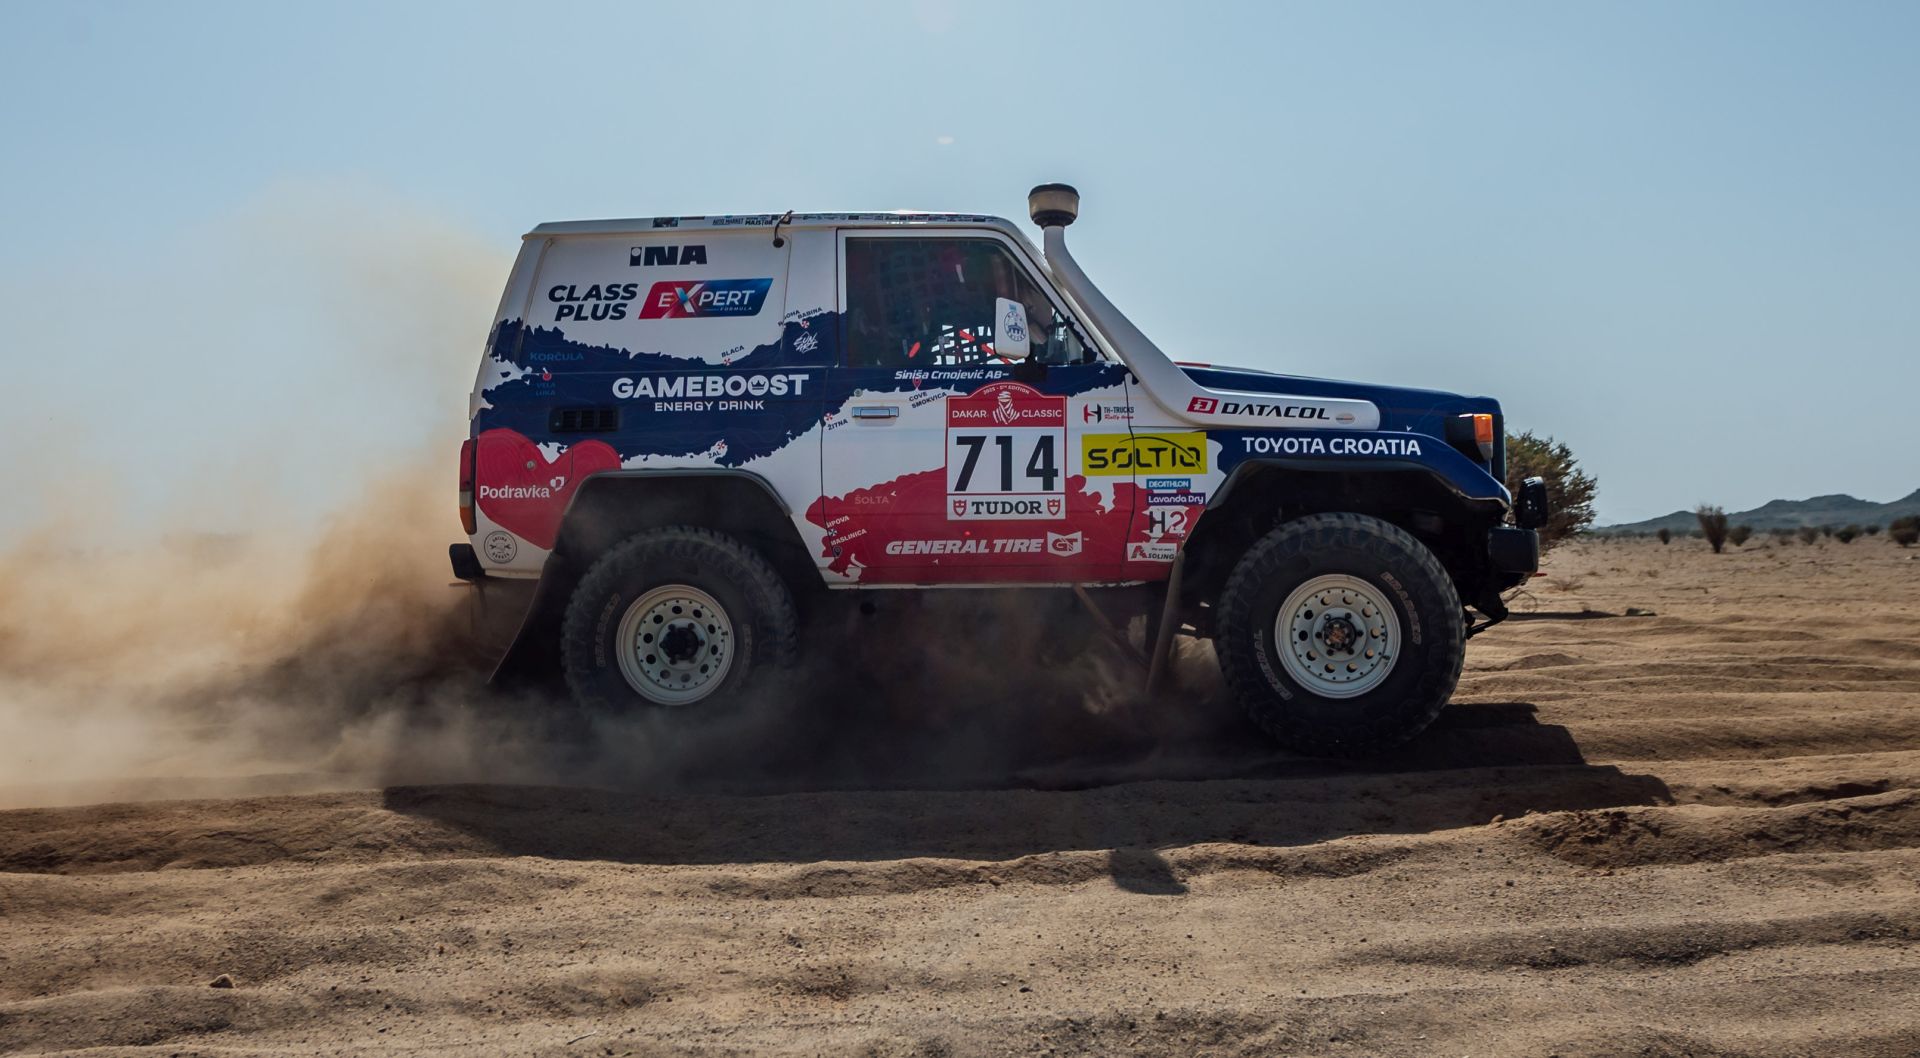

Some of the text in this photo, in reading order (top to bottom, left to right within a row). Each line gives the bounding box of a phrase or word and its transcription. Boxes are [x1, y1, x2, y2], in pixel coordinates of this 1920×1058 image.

[629, 245, 707, 266] INA
[548, 283, 639, 302] CLASS
[658, 283, 756, 313] EXPERT
[554, 303, 629, 321] PLUS
[721, 345, 745, 358] BLACA
[894, 369, 930, 380] Siniša
[931, 369, 985, 380] Crnojević
[612, 374, 809, 399] GAMEBOOST
[909, 391, 928, 402] COVE
[911, 392, 947, 409] SMOKVICA
[654, 400, 765, 412] ENERGY DRINK
[952, 409, 1062, 419] DAKAR CLASSIC
[1221, 402, 1330, 420] DATACOL
[1242, 437, 1422, 456] TOYOTA CROATIA
[954, 435, 1058, 491] 714
[479, 484, 550, 499] Podravka
[1148, 480, 1189, 488] DECATHLON
[854, 494, 889, 505] ŠOLTA
[1148, 494, 1204, 505] Lavanda Dry
[971, 501, 1043, 515] TUDOR
[886, 538, 1044, 555] GENERAL TIRE
